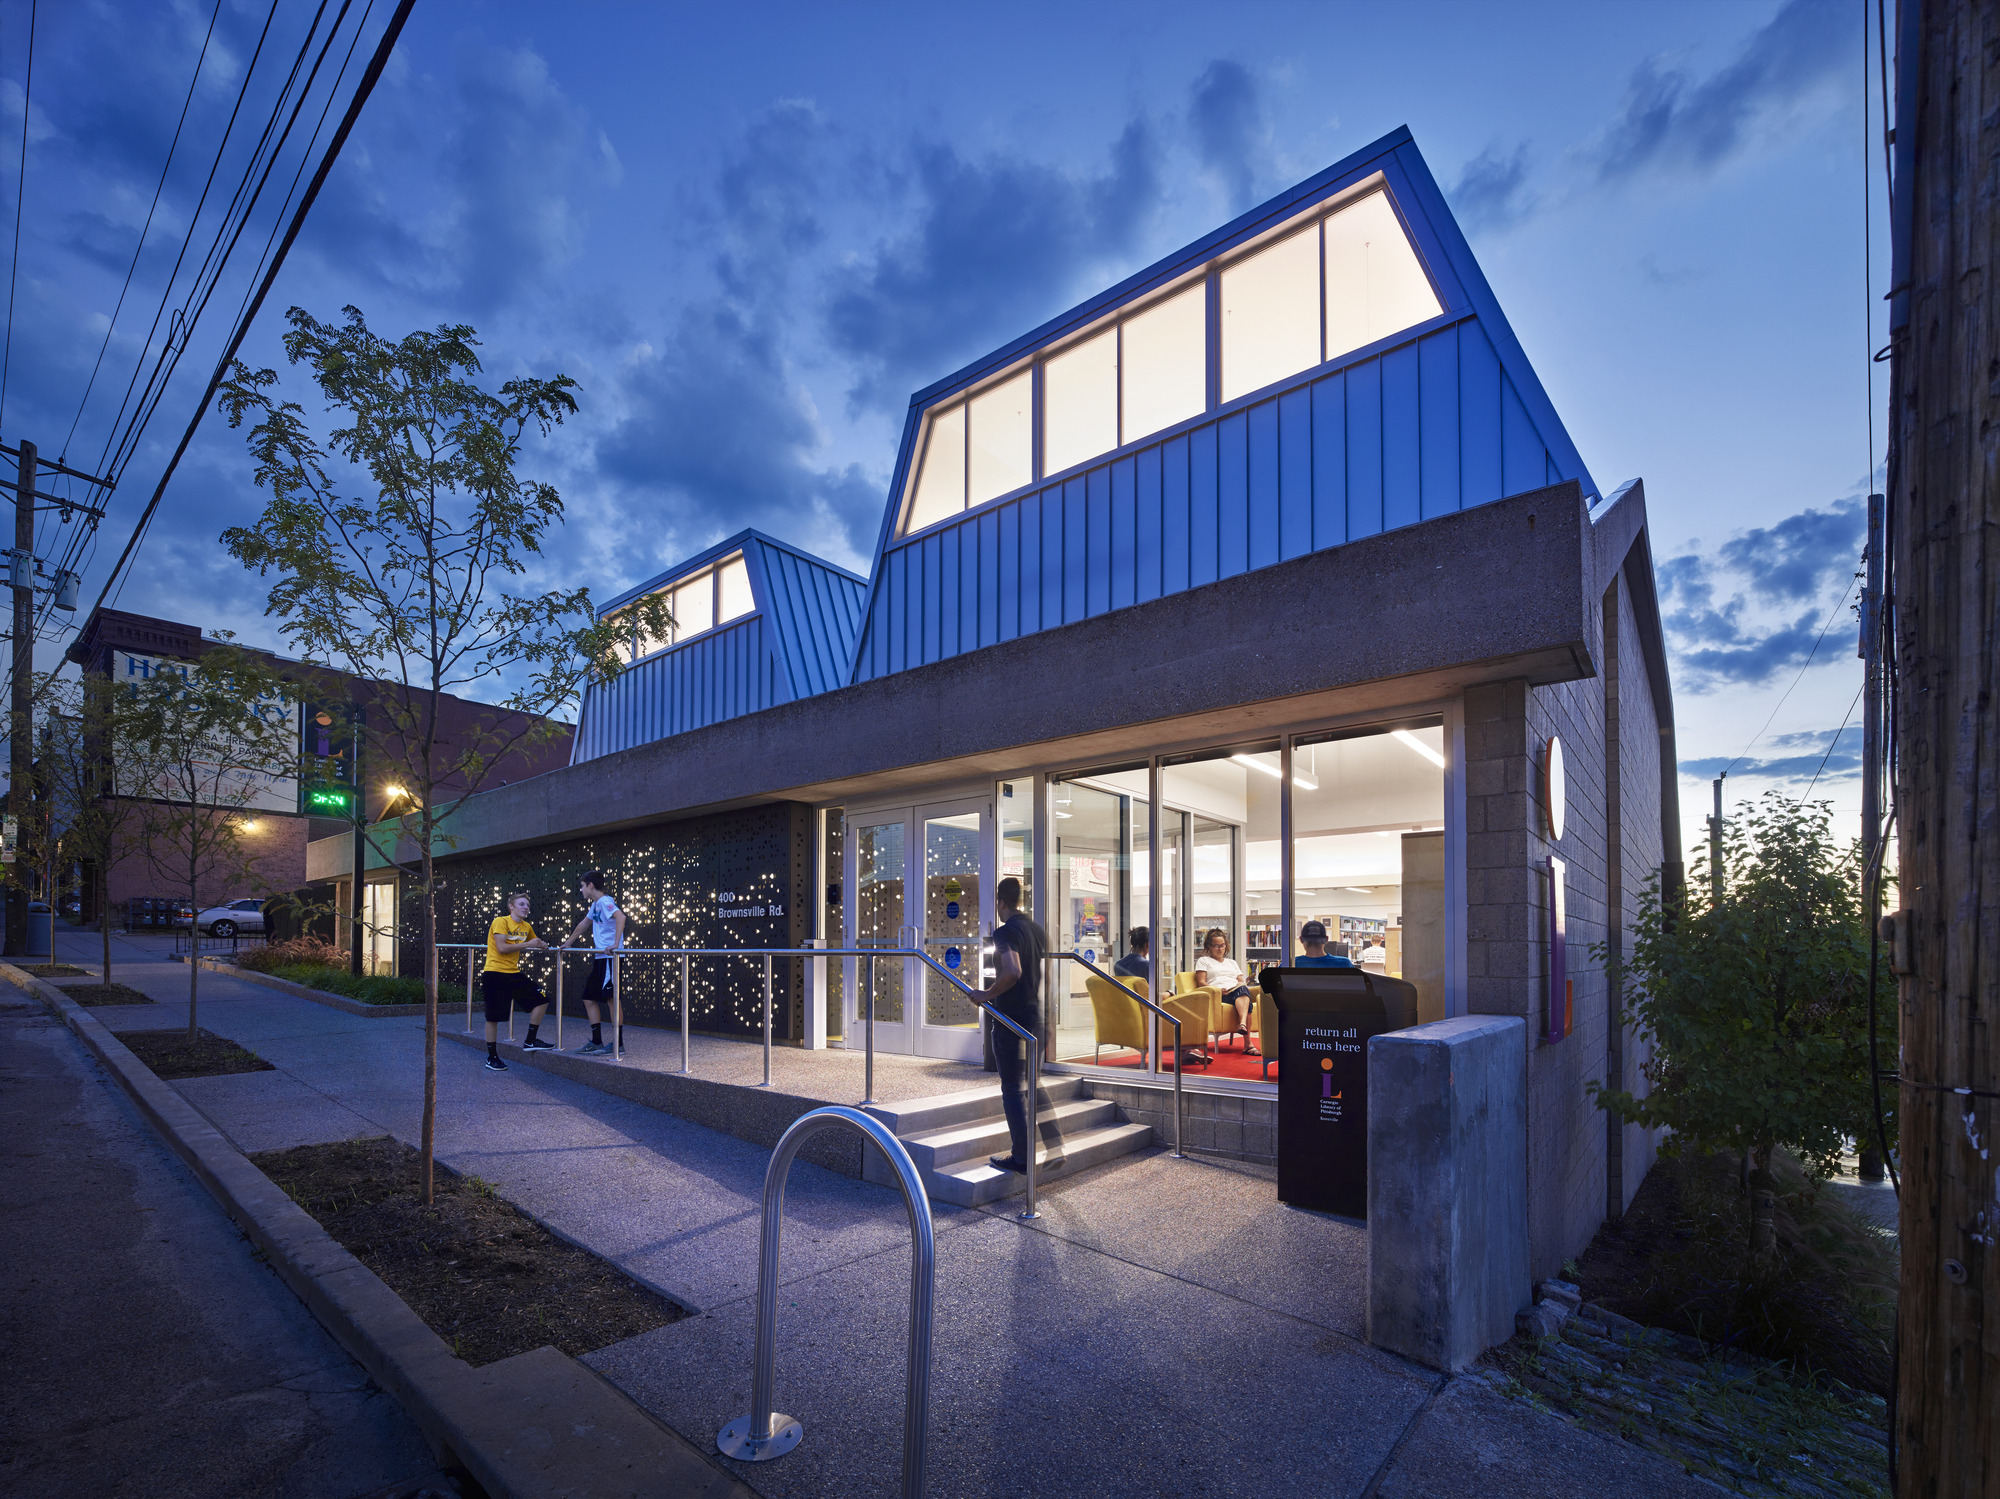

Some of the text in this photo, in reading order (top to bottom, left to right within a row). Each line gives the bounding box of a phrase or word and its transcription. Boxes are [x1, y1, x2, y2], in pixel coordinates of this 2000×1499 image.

[192, 752, 233, 765] SERVIE
[718, 892, 735, 903] 400
[718, 905, 784, 919] Brownsville Rd.
[1305, 1027, 1357, 1038] return all
[1302, 1040, 1361, 1053] items here
